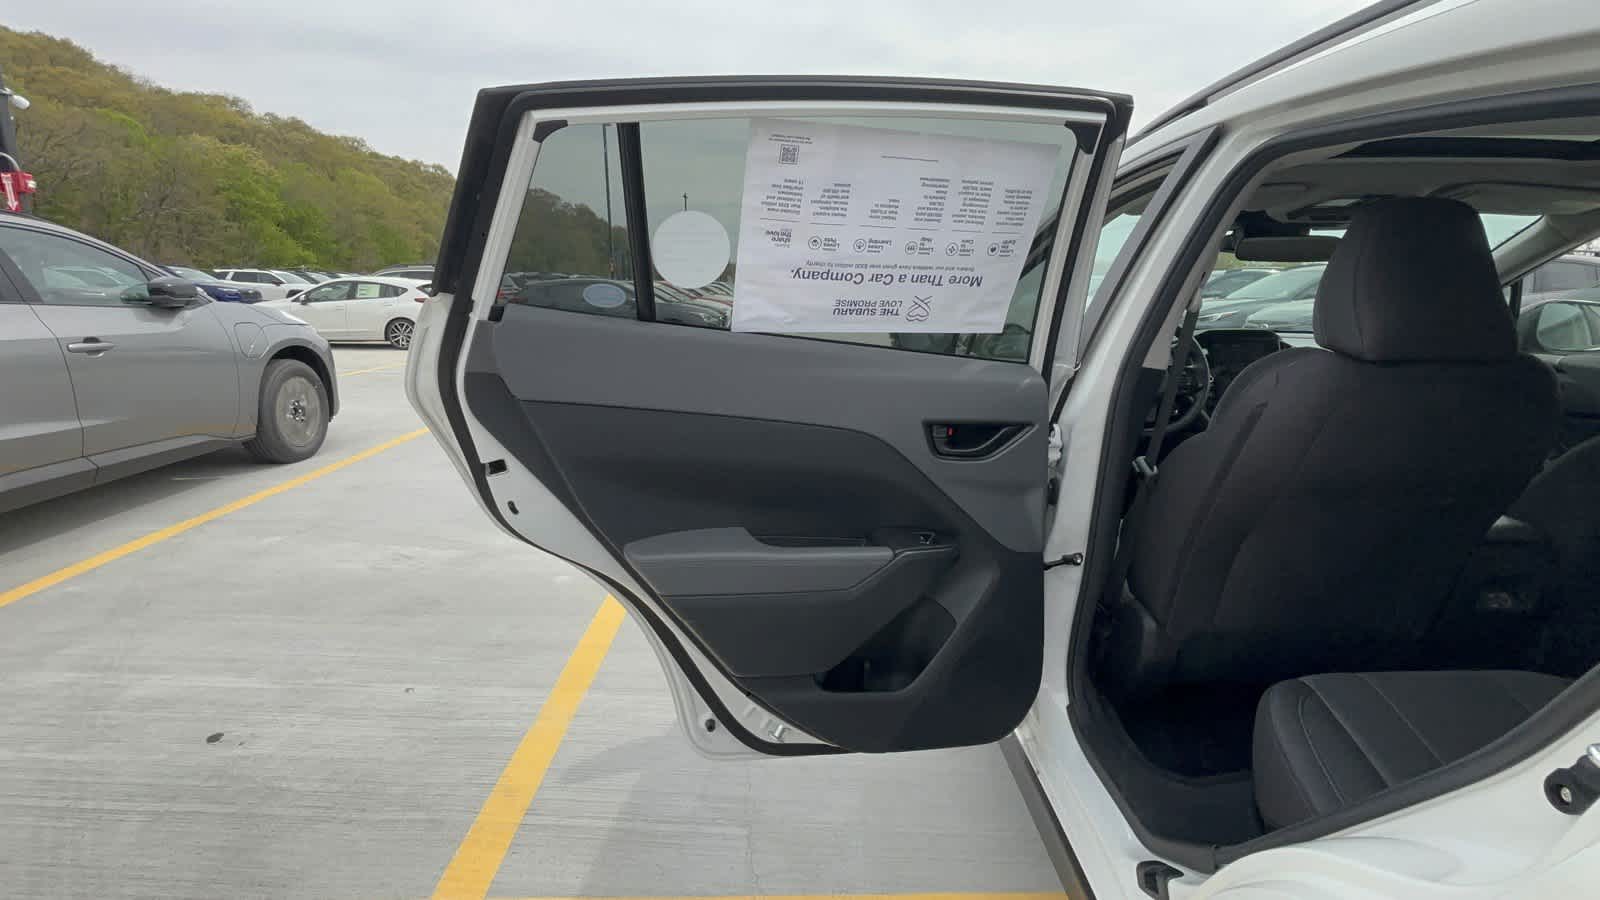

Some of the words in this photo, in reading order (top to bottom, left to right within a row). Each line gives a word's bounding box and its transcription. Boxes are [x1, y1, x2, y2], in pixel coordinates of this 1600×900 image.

[791, 268, 864, 284] Company.
[869, 274, 894, 285] Car
[899, 274, 906, 283] a
[912, 274, 943, 286] Than
[949, 276, 983, 287] More
[832, 308, 876, 316] SUBARU
[880, 308, 899, 316] THE
